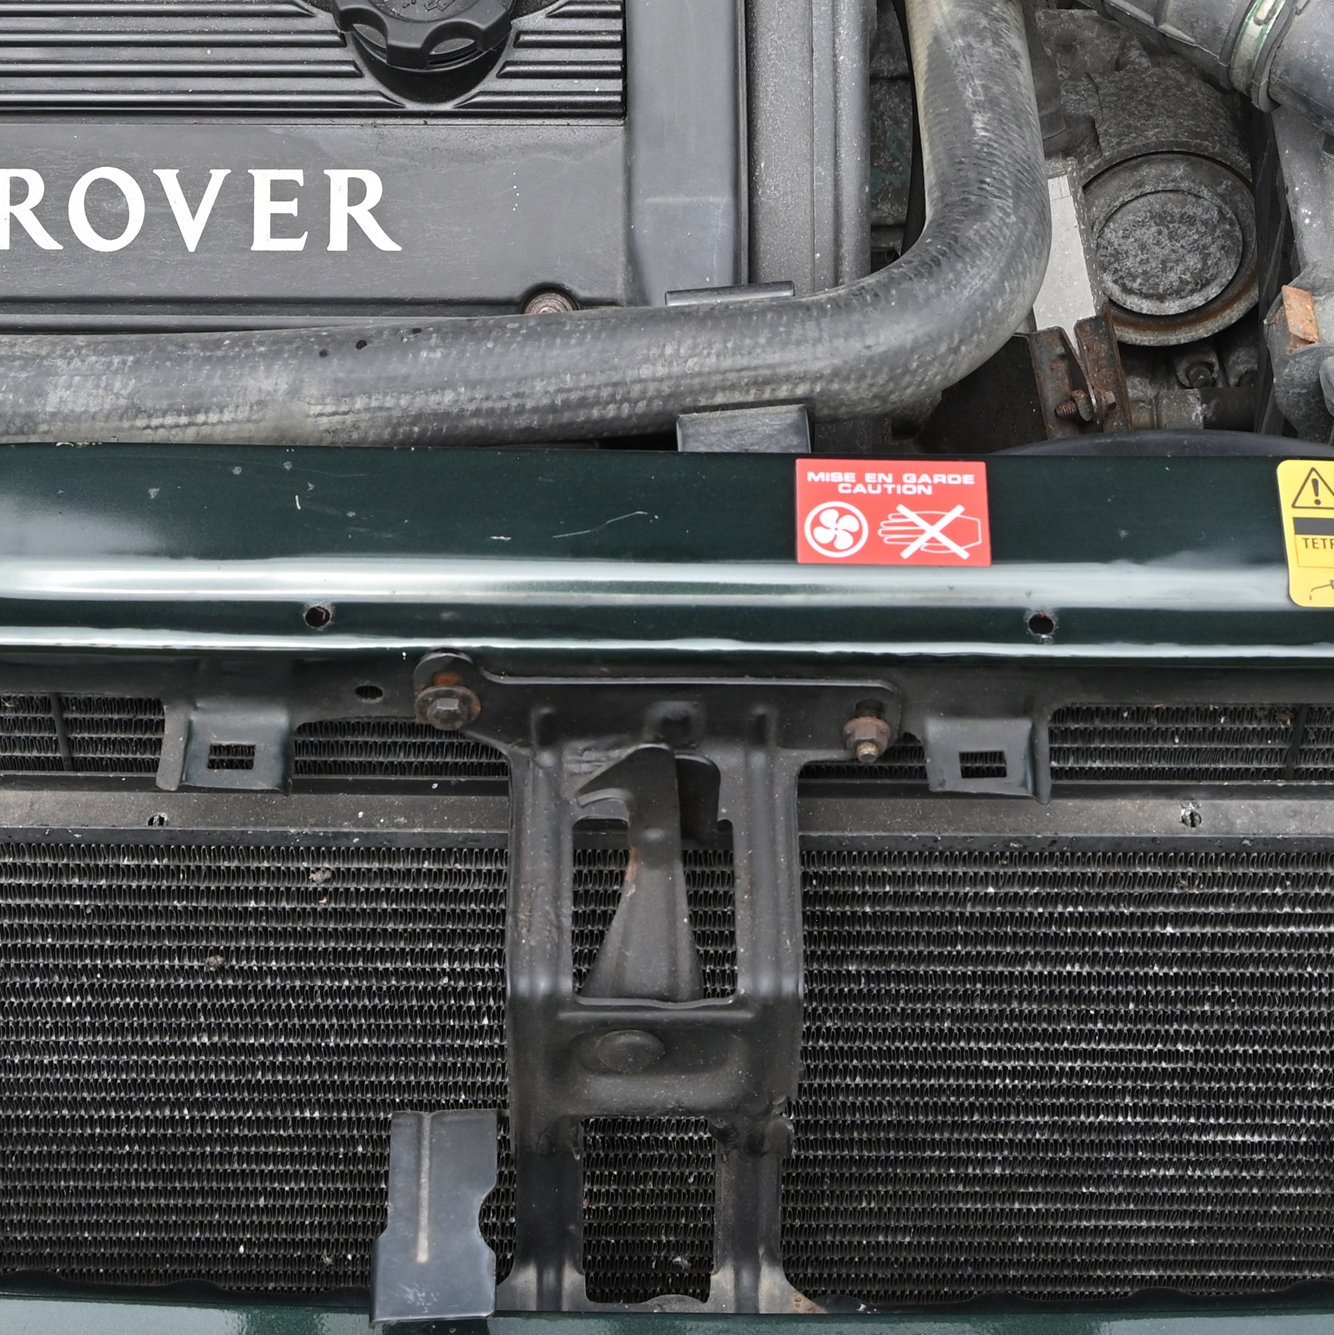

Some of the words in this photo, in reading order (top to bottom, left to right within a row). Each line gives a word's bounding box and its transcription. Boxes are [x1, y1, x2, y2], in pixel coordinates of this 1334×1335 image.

[807, 472, 856, 482] MISE
[865, 473, 892, 483] EN
[903, 473, 975, 484] GARDE
[838, 483, 932, 494] CAUTION
